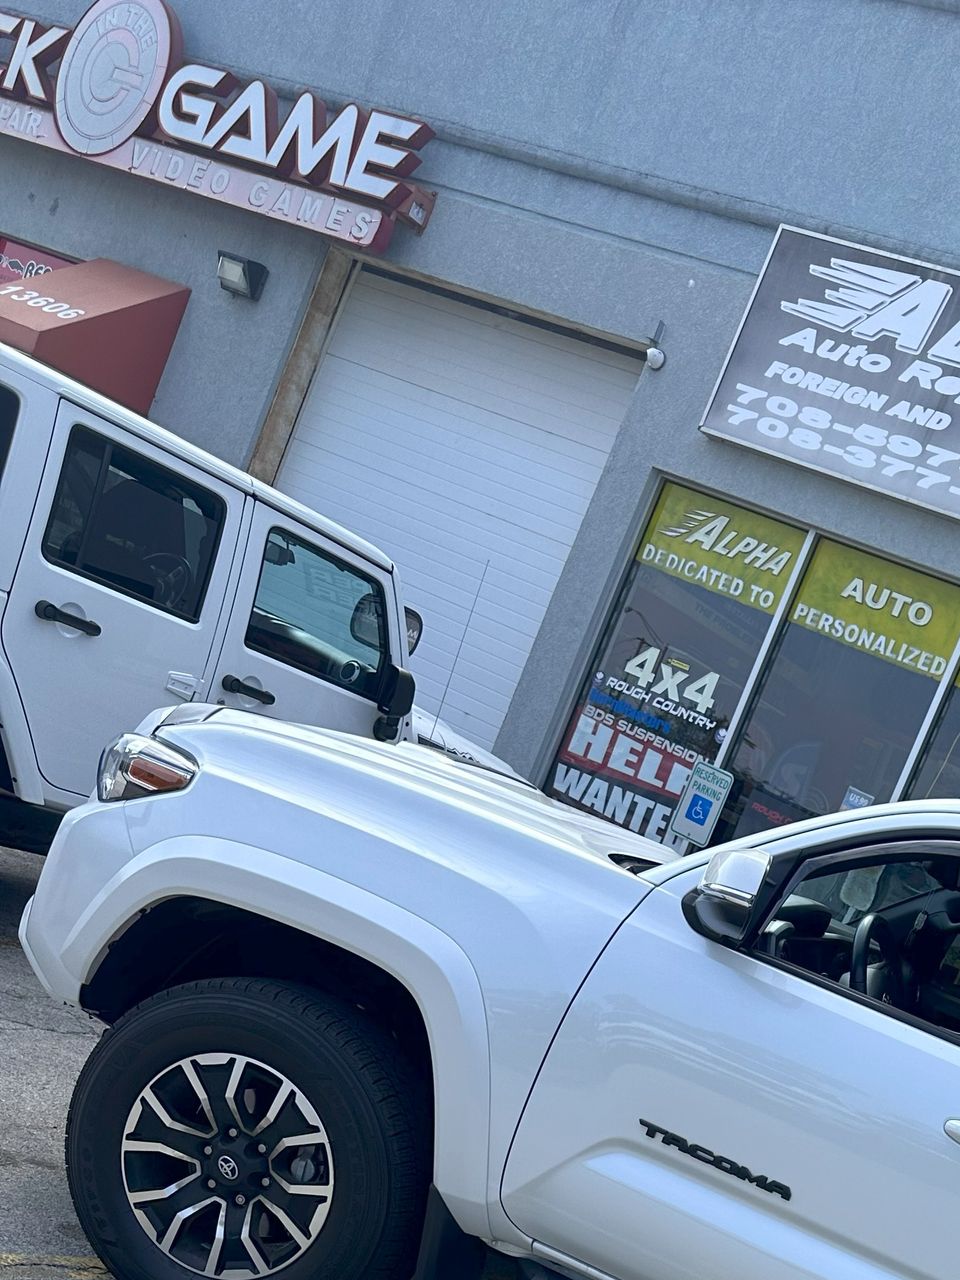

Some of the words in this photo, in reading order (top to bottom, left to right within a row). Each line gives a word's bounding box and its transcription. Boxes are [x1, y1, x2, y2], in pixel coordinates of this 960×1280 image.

[158, 63, 428, 201] GAME
[131, 139, 231, 194] VIDEO
[247, 181, 373, 240] GAMES
[0, 286, 85, 319] 13606
[778, 326, 892, 374] Auto
[763, 360, 890, 412] FOREIGN
[885, 400, 952, 431] AND
[684, 515, 793, 576] ALPHA
[642, 543, 745, 597] DEDICATED
[750, 584, 775, 609] TO
[840, 577, 934, 627] AUTO
[792, 602, 948, 676] PERSONALIZED
[583, 704, 616, 726] BDS
[605, 676, 653, 703] ROUGH
[652, 697, 718, 731] COUNTRY
[691, 780, 723, 801] PARKING
[693, 766, 729, 790] RESERVED
[638, 1117, 793, 1202] TACOMA
